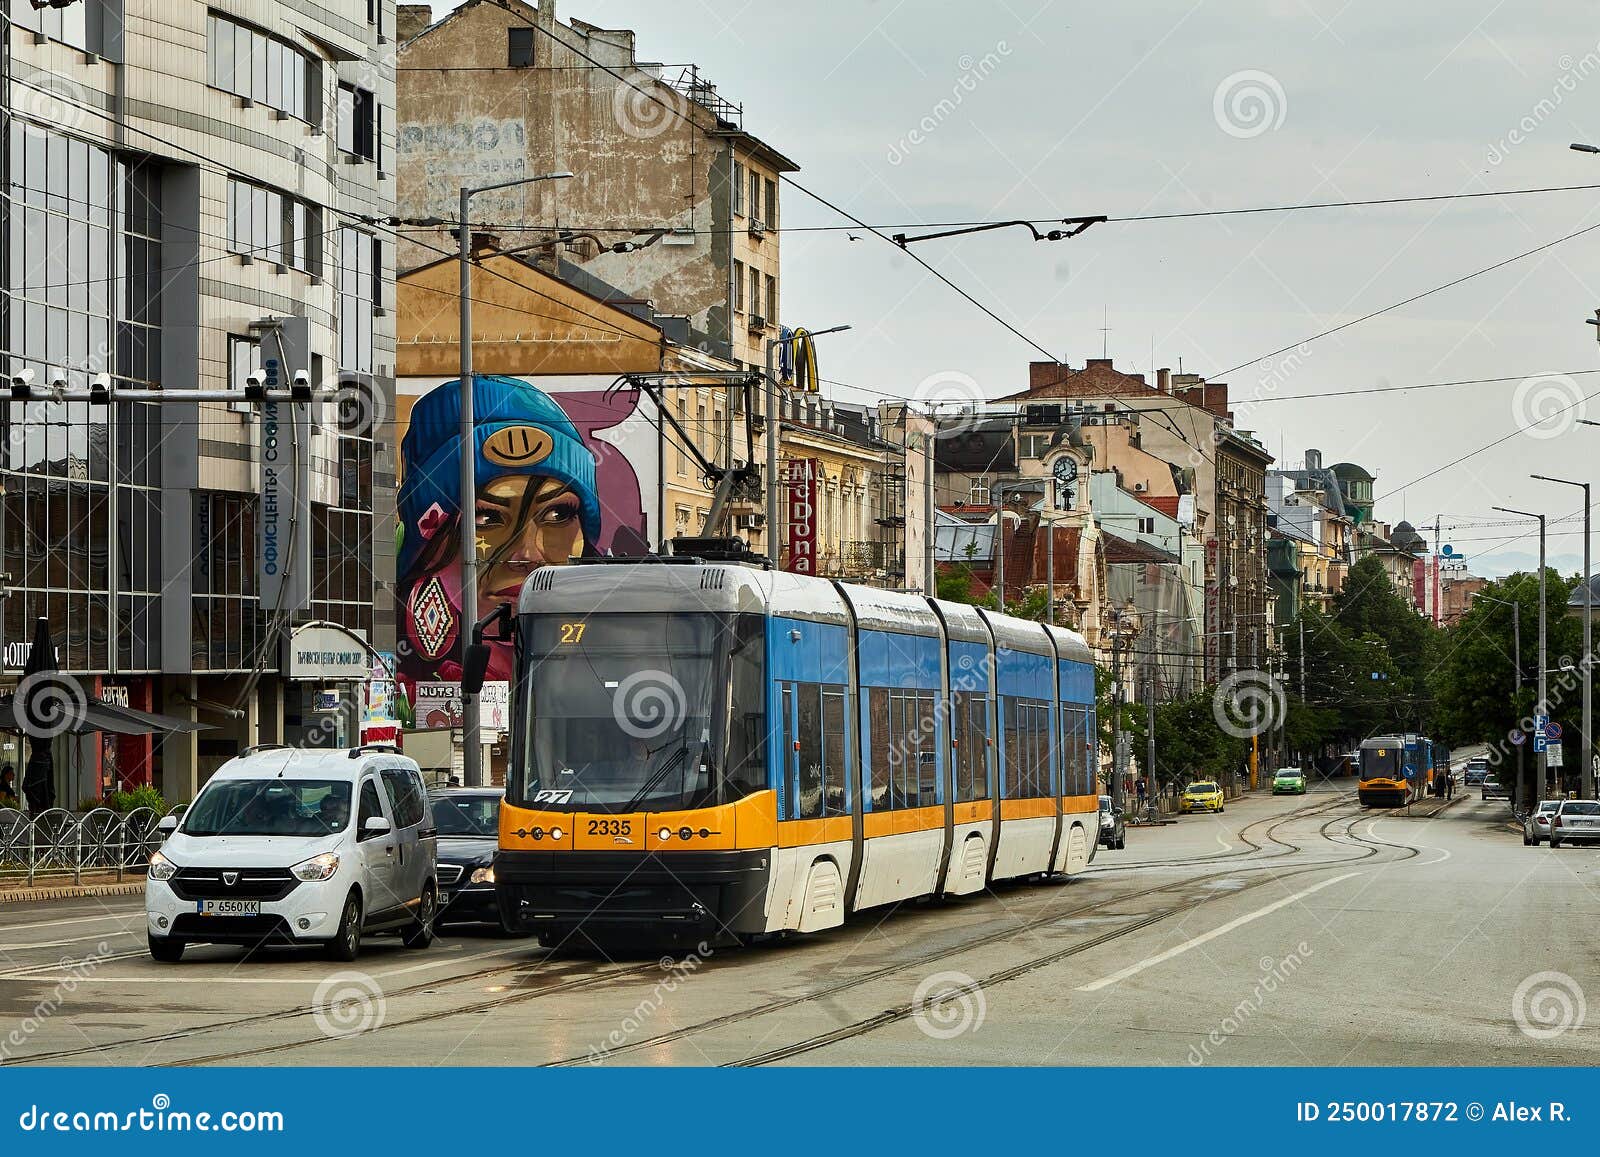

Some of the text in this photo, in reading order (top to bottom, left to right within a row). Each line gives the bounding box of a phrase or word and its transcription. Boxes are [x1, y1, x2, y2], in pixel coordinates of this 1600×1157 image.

[265, 401, 279, 461] СОФИЯ
[265, 468, 278, 575] ОФИСЦЕНТЪР
[561, 624, 586, 643] 27
[419, 687, 453, 698] NUTS
[1378, 749, 1386, 757] 18
[536, 791, 570, 803] 27
[588, 820, 631, 836] 2335
[207, 901, 214, 912] P
